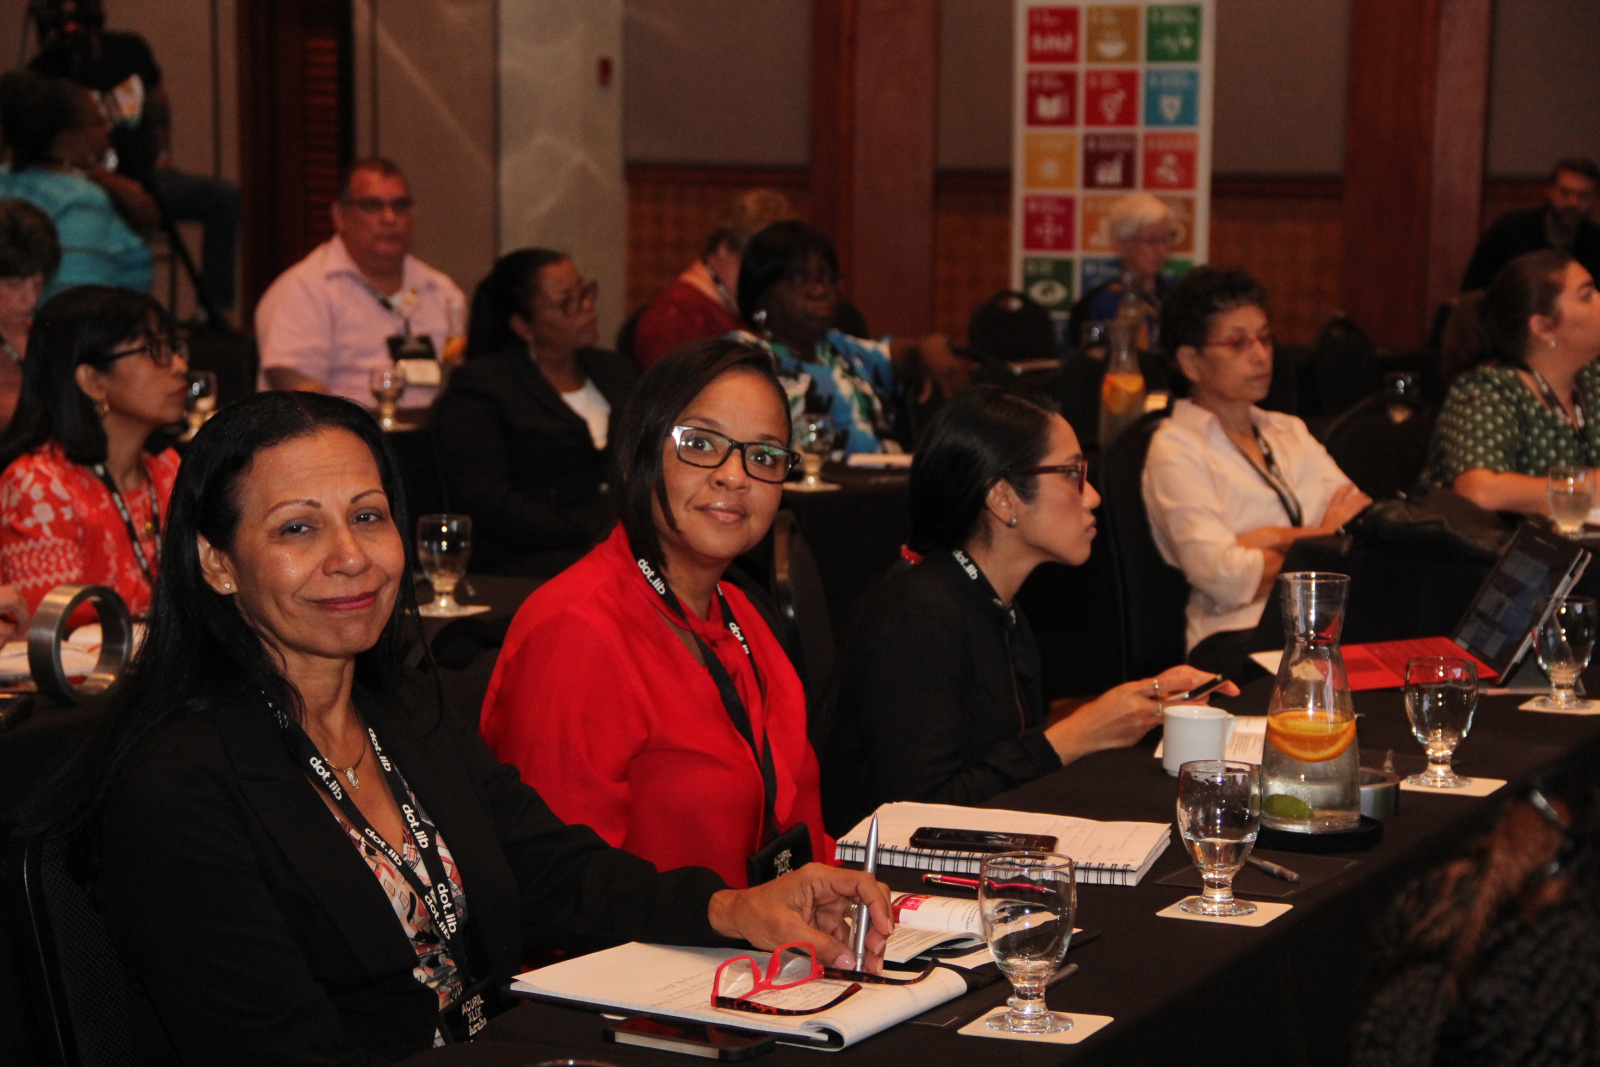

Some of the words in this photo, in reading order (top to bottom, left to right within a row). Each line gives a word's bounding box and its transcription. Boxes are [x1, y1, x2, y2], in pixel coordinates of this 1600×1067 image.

[638, 559, 666, 595] dot.lib
[952, 550, 978, 580] dot.lib
[729, 622, 749, 654] dotli
[368, 727, 392, 772] dot.lib
[309, 756, 343, 800] dot.lib
[364, 827, 402, 866] dot.lib
[402, 804, 429, 849] dot.lib
[424, 894, 451, 940] dot.lib
[437, 883, 457, 933] dot.lib
